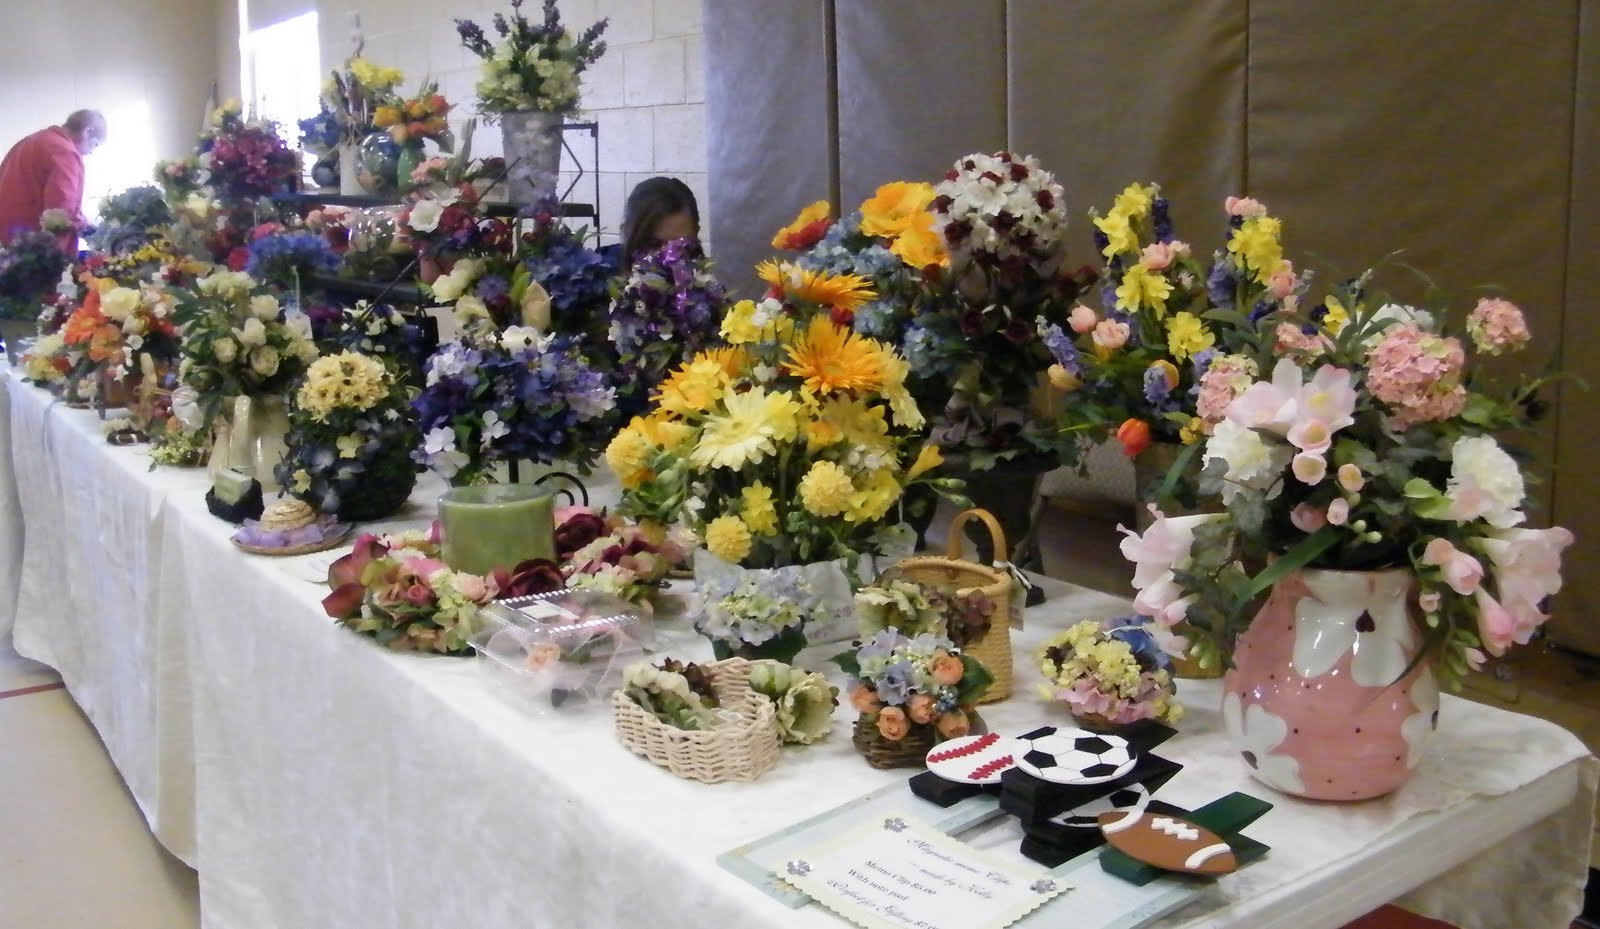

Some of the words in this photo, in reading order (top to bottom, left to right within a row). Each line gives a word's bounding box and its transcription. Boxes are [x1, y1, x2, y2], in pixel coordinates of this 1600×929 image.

[847, 868, 870, 884] With
[869, 880, 890, 893] note
[889, 889, 910, 902] pad
[864, 860, 892, 877] Memo
[892, 873, 911, 887] Clip
[910, 882, 937, 896] $5.00
